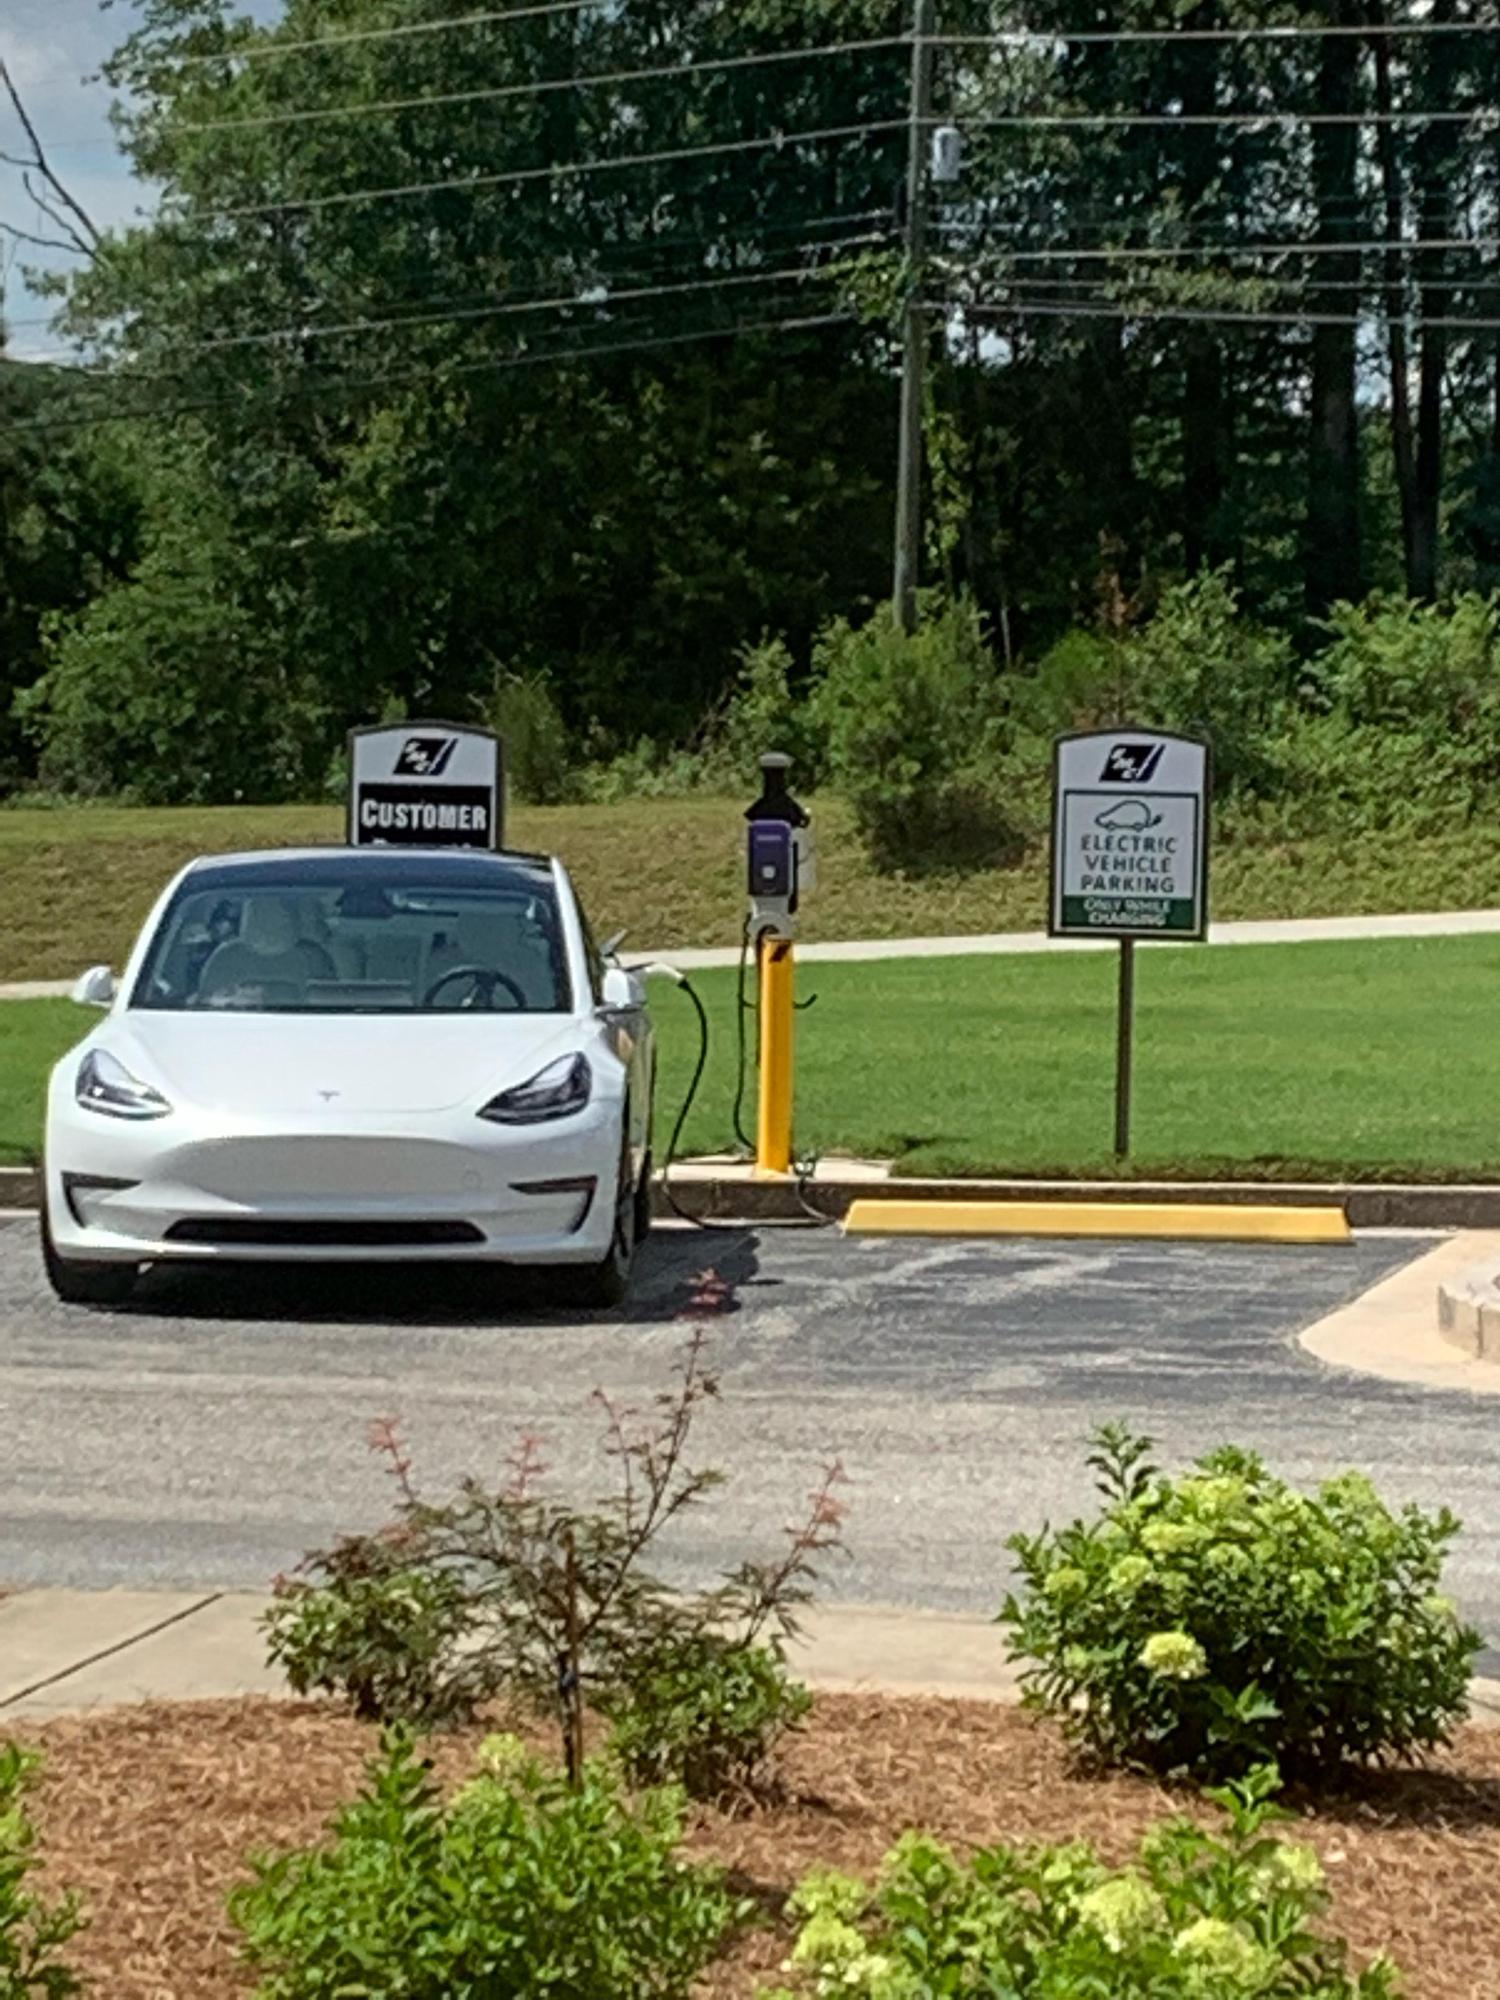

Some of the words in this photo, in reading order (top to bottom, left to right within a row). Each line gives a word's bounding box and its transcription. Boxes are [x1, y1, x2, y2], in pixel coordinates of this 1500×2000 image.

[361, 798, 487, 830] CUSTOMER
[1081, 834, 1177, 853] ELECTRIC
[1085, 854, 1171, 873] VEHICLE
[1081, 875, 1174, 893] PARKING
